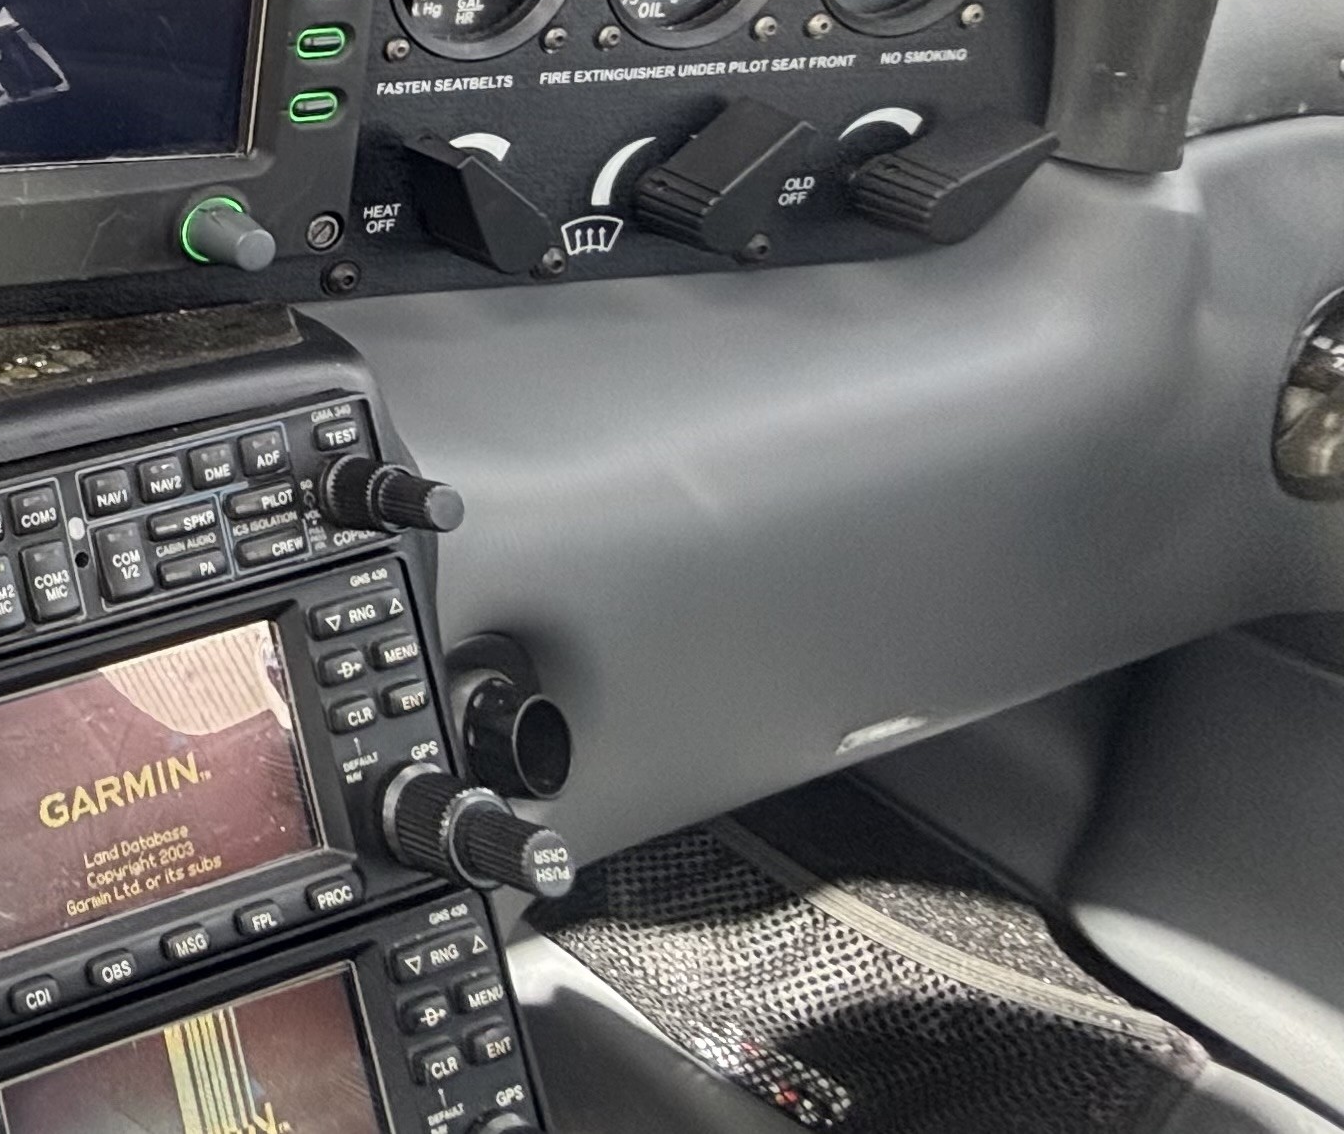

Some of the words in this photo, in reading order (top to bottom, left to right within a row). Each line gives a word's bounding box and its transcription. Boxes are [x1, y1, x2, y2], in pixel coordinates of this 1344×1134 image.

[881, 52, 901, 64] NO
[904, 48, 967, 63] SMOKING
[540, 72, 571, 84] FIRE
[574, 65, 674, 83] EXTINGUISHER
[678, 62, 725, 78] UNDER
[729, 59, 768, 74] PILOT
[771, 57, 807, 72] SEAT
[809, 54, 855, 69] FRONT
[377, 81, 430, 95] FASTEN
[434, 75, 513, 92] SEATBELTS
[363, 204, 401, 218] HEAT
[365, 219, 395, 233] OFF
[325, 429, 356, 445] TEST
[257, 451, 280, 468] ADF
[205, 465, 231, 482] DME
[150, 477, 182, 494] NAV2
[97, 490, 128, 507] NAV1
[21, 507, 57, 528] COM3
[349, 604, 376, 623] RNG
[384, 644, 418, 663] MENU
[411, 741, 438, 760] GPS
[39, 752, 201, 829] GARMIN
[122, 825, 188, 855] Database
[87, 850, 157, 890] Copyright
[160, 842, 195, 865] 2003
[66, 890, 112, 916] Garmin
[317, 886, 353, 908] PROC
[251, 912, 277, 931] FPL
[175, 934, 207, 957] MSG
[101, 961, 132, 982] OBS
[25, 989, 51, 1009] CDI
